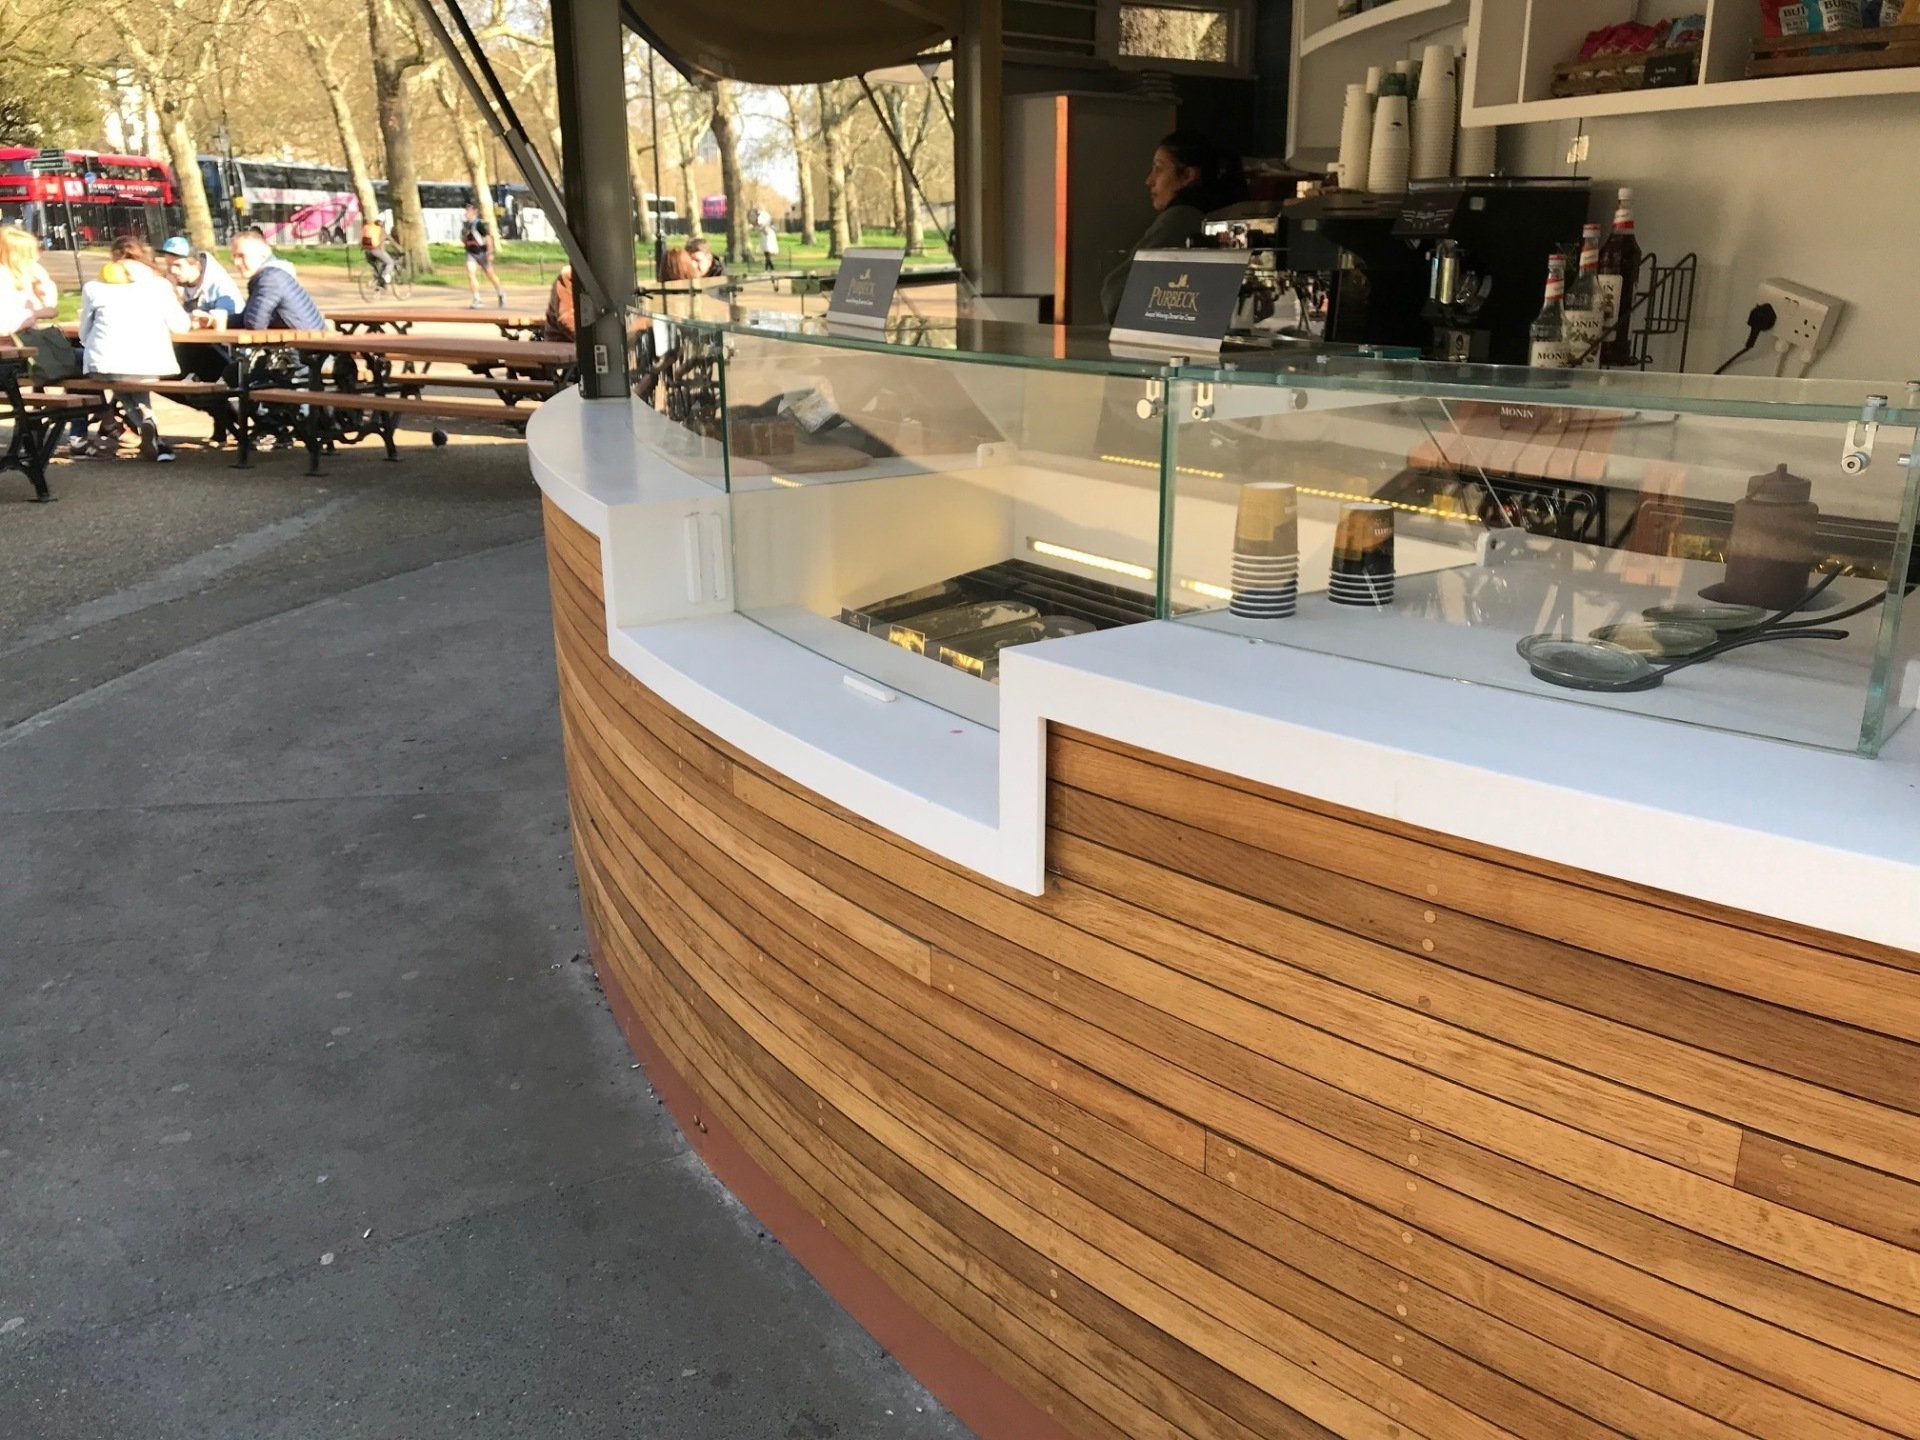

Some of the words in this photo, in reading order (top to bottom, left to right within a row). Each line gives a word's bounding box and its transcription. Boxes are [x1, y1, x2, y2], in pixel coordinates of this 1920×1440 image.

[1148, 286, 1200, 312] PURBECK
[1571, 320, 1600, 329] ONIN
[1501, 406, 1534, 419] MONIN
